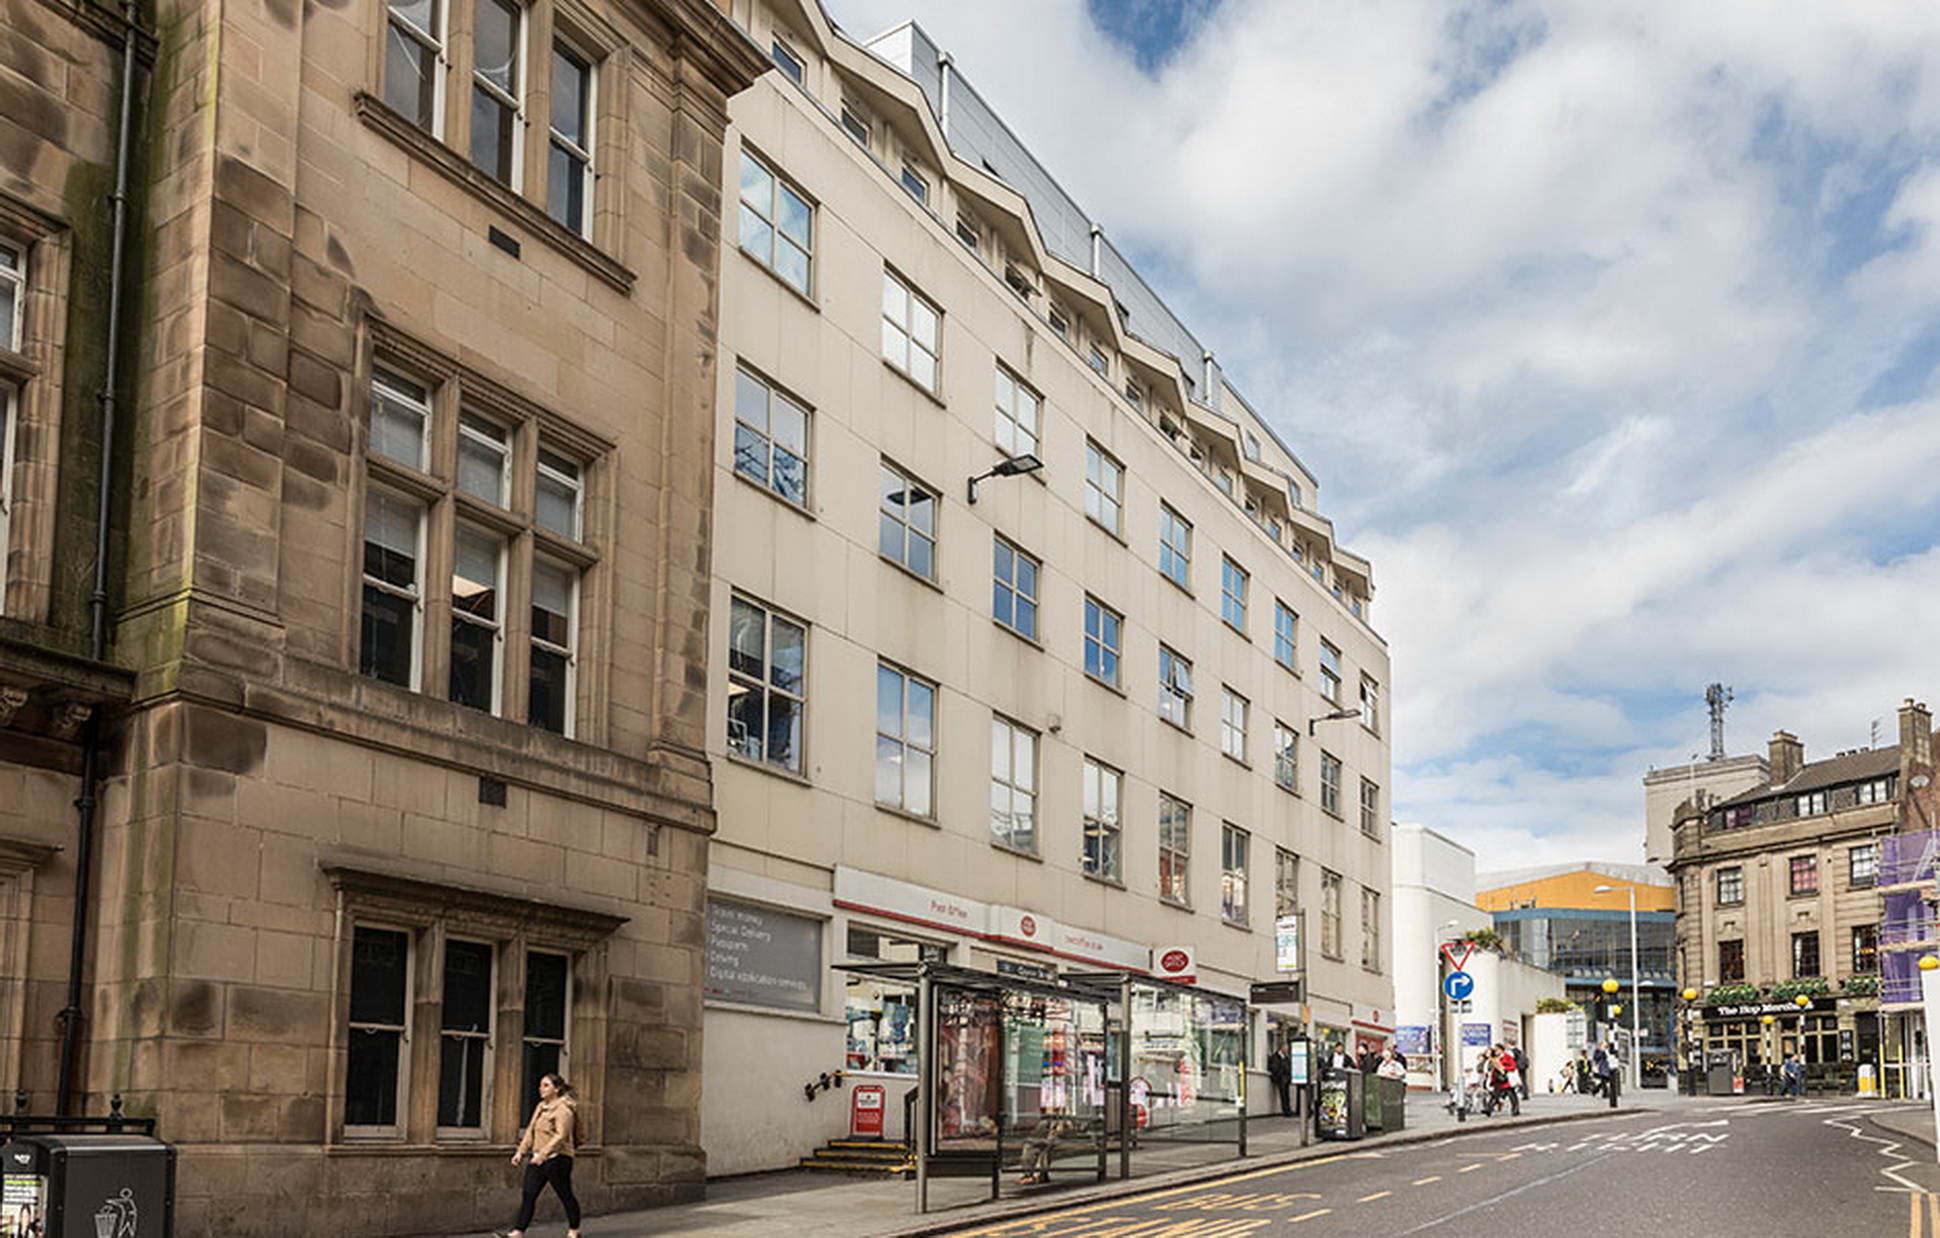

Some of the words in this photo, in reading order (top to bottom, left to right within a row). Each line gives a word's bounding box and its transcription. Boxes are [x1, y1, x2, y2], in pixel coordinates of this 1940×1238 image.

[1718, 1006, 1738, 1015] The
[1739, 1005, 1761, 1015] Hop
[1154, 1194, 1322, 1211] BUS
